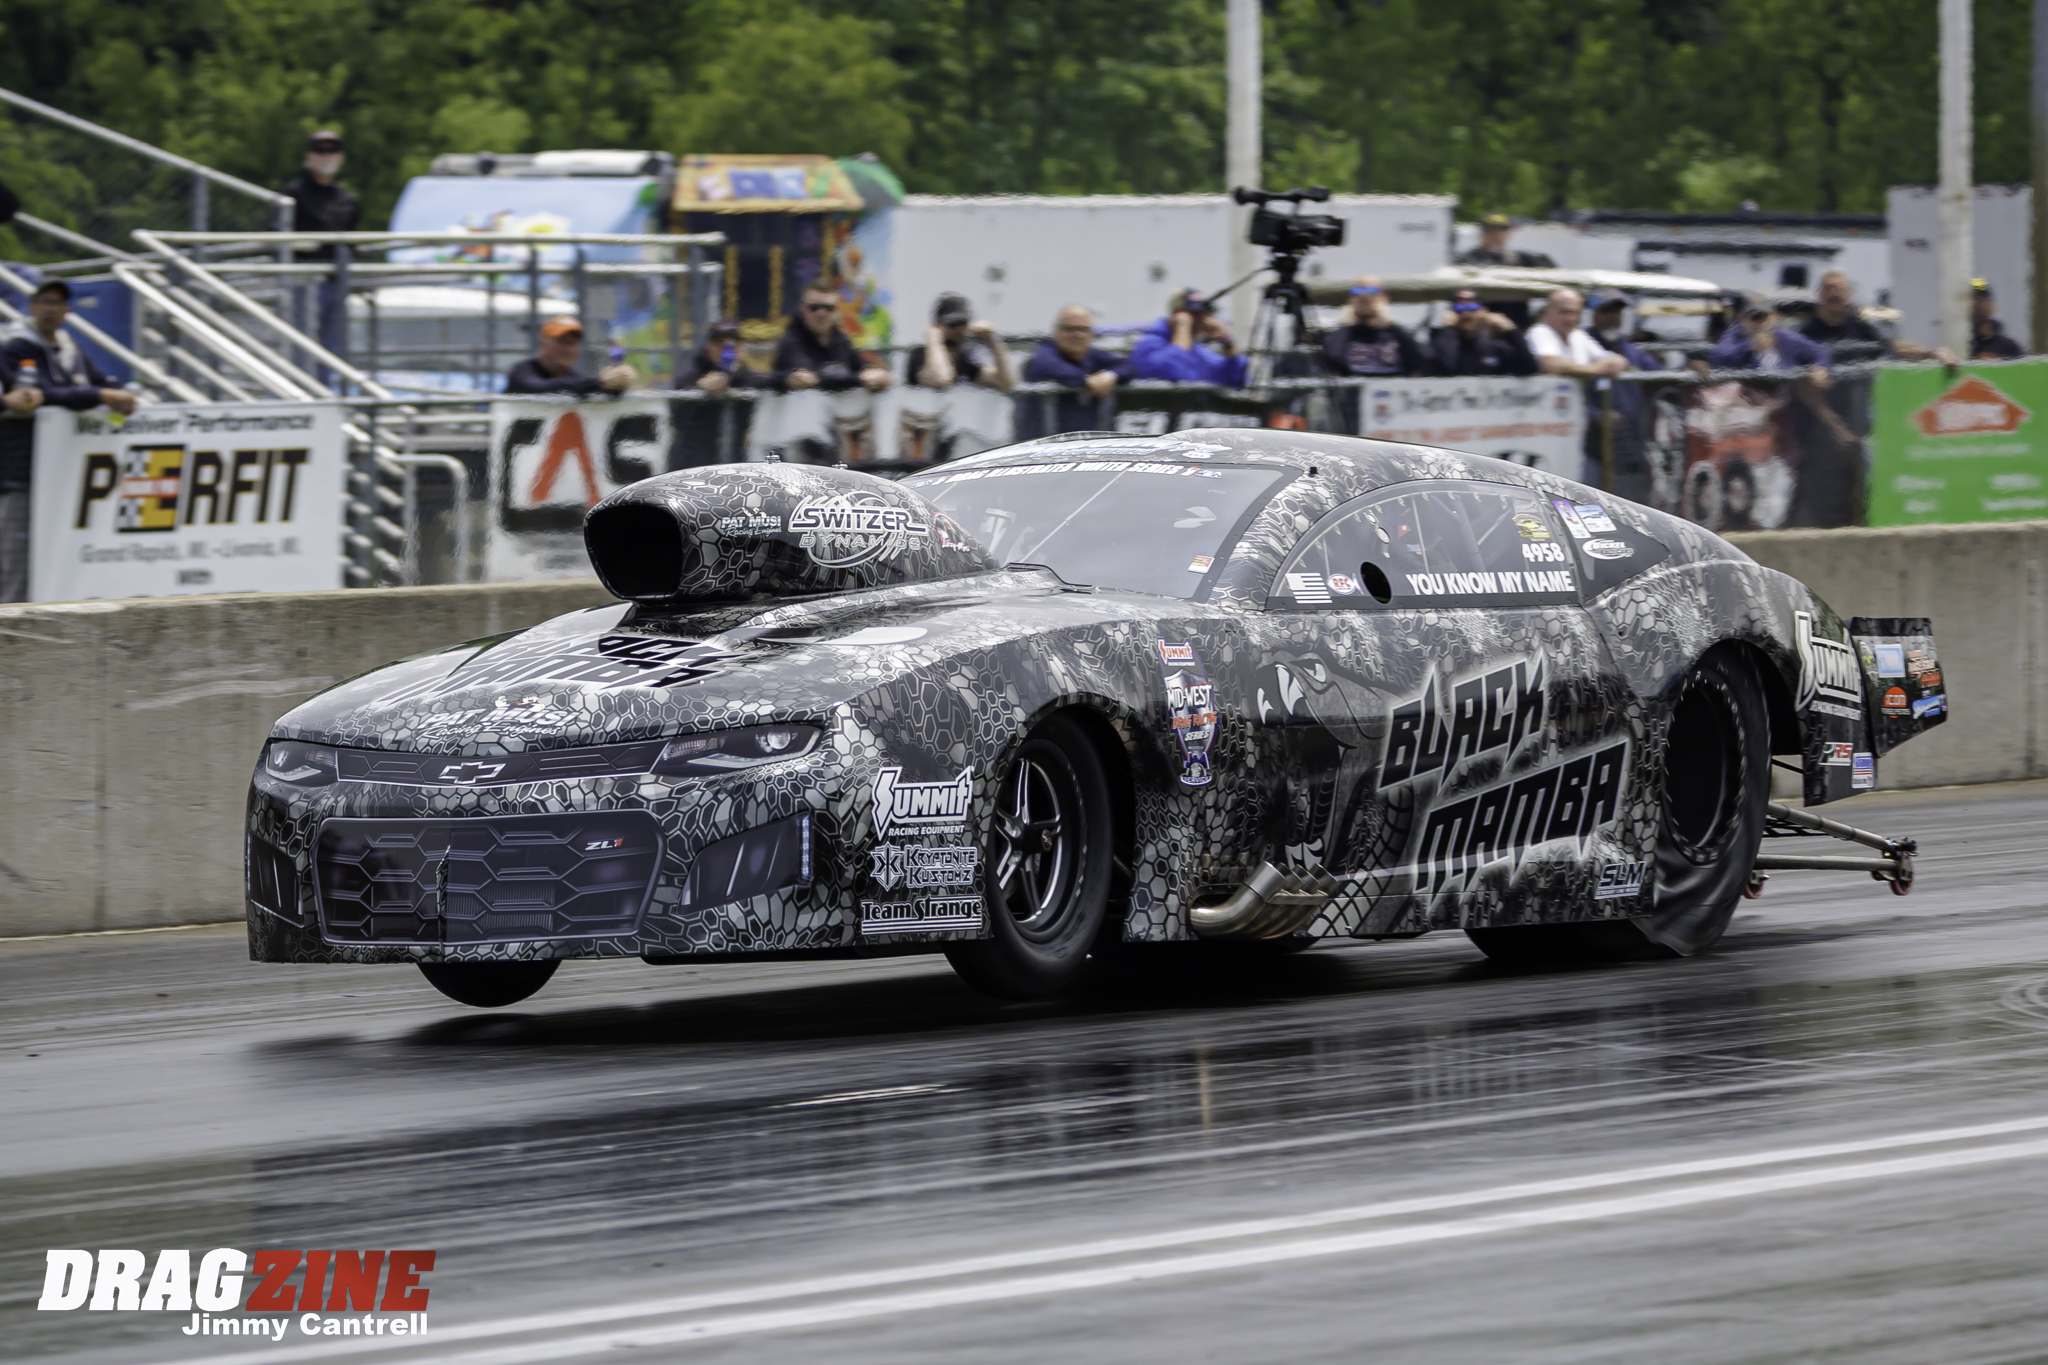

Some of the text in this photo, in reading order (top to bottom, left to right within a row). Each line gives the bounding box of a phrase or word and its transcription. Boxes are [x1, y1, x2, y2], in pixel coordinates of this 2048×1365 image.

[184, 412, 314, 431] Performance
[945, 470, 990, 484] DRAG
[985, 462, 1077, 479] ILLUSTRATED
[1073, 462, 1132, 472] WINTER
[1127, 462, 1184, 475] SERIES
[75, 444, 311, 534] PERFIT
[721, 515, 781, 528] PAT MUSI
[789, 507, 929, 535] SWITZER
[725, 526, 782, 538] Racing Engines
[800, 533, 921, 550] DYNAMICS
[1521, 543, 1565, 562] 4958
[1406, 571, 1575, 595] YOU KNOW MY NAME
[1166, 684, 1213, 709] MID-WEST
[417, 706, 583, 729] PAT MUSI
[1172, 711, 1218, 730] DRAG RACING
[1376, 646, 1547, 797] BLACK
[416, 720, 562, 741] Racing Engines
[888, 825, 966, 837] RACING EQUIPMENT
[1412, 737, 1630, 916] MAMBA
[584, 838, 624, 851] ZL1
